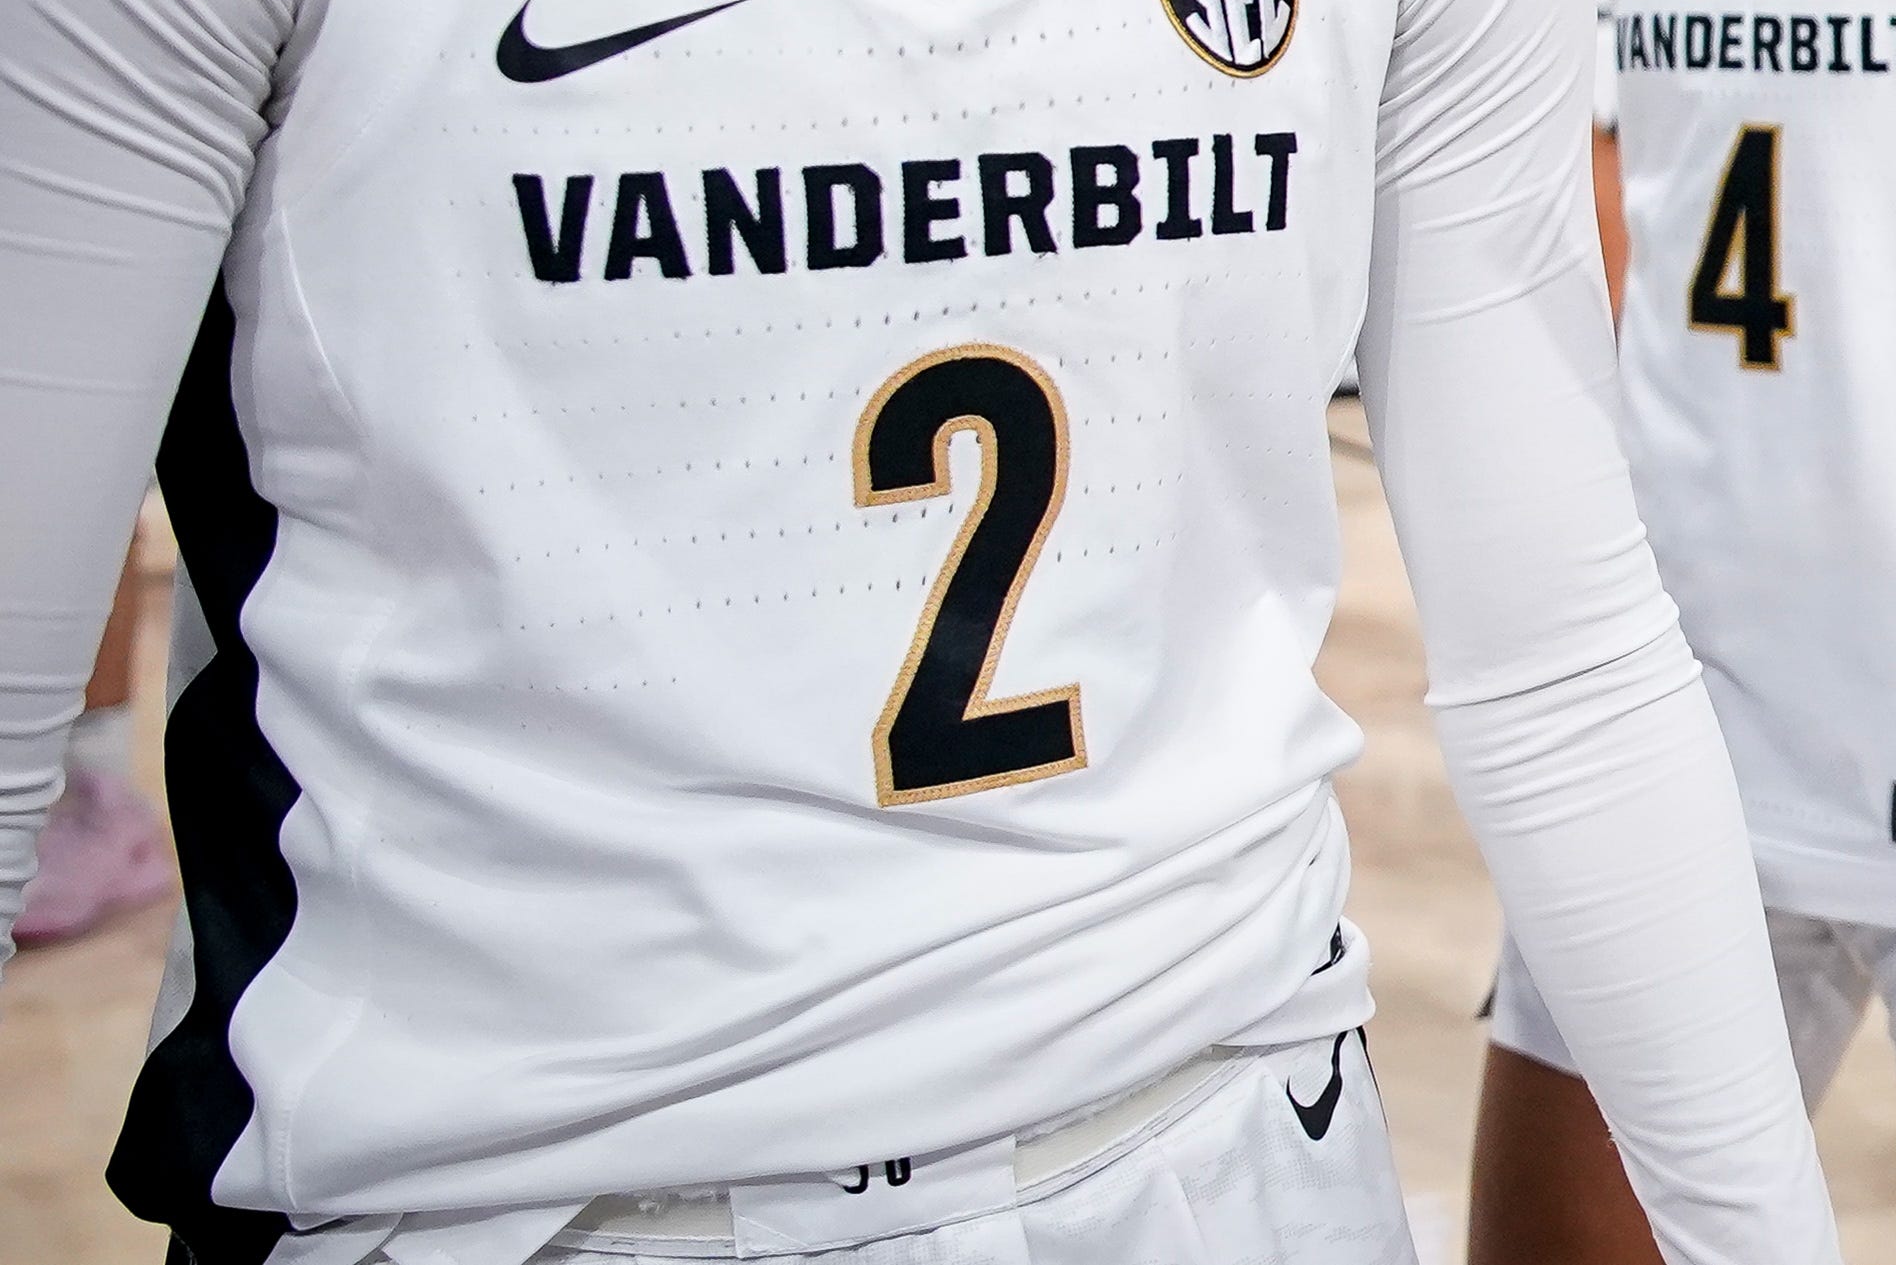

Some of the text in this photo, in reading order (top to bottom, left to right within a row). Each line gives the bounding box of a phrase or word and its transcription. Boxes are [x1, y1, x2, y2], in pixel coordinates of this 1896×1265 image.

[512, 132, 1297, 284] VANDERBILT
[1688, 122, 1797, 372] 4
[852, 342, 1089, 808] 2
